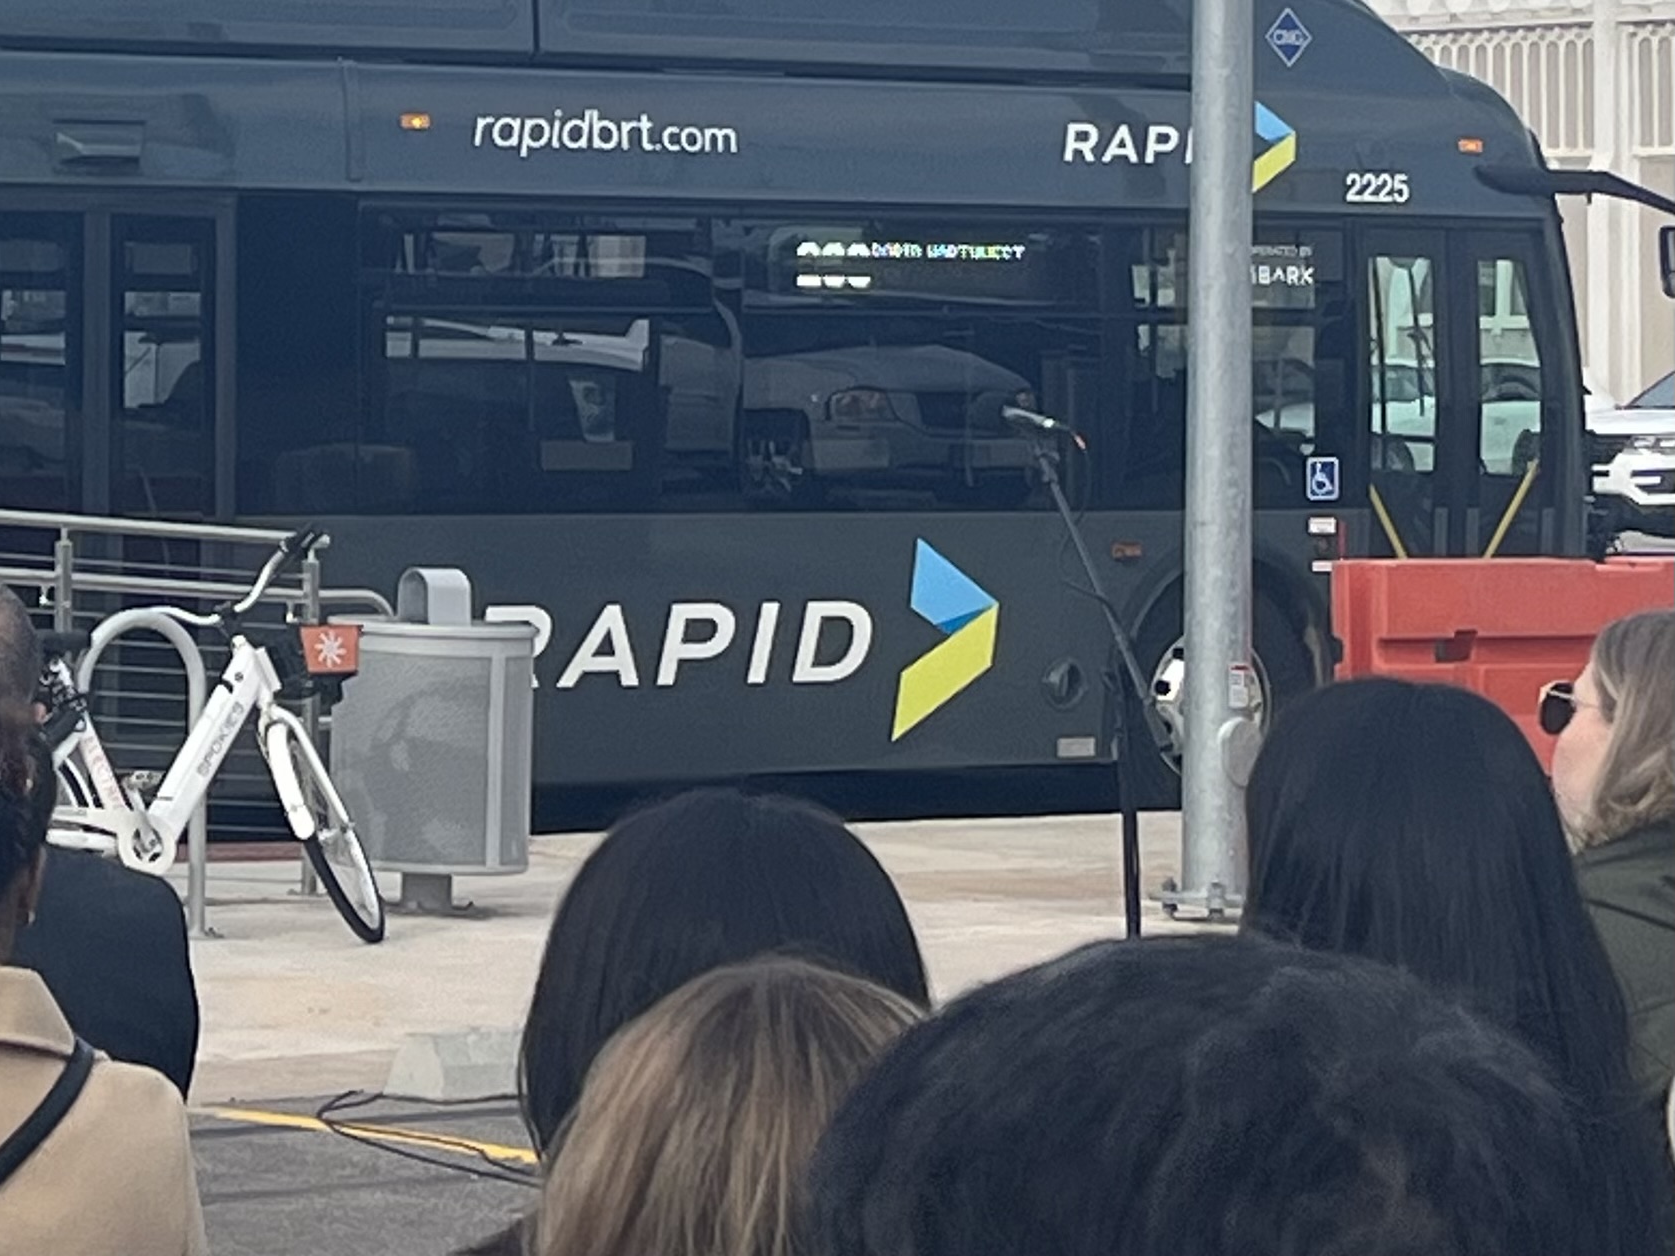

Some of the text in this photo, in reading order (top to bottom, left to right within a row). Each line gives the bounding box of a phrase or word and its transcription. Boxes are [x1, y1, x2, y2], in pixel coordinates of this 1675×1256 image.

[474, 108, 738, 158] rapidbrt.com
[1063, 121, 1193, 165] RAPI
[1346, 172, 1410, 203] 2225
[1250, 265, 1315, 286] BARK
